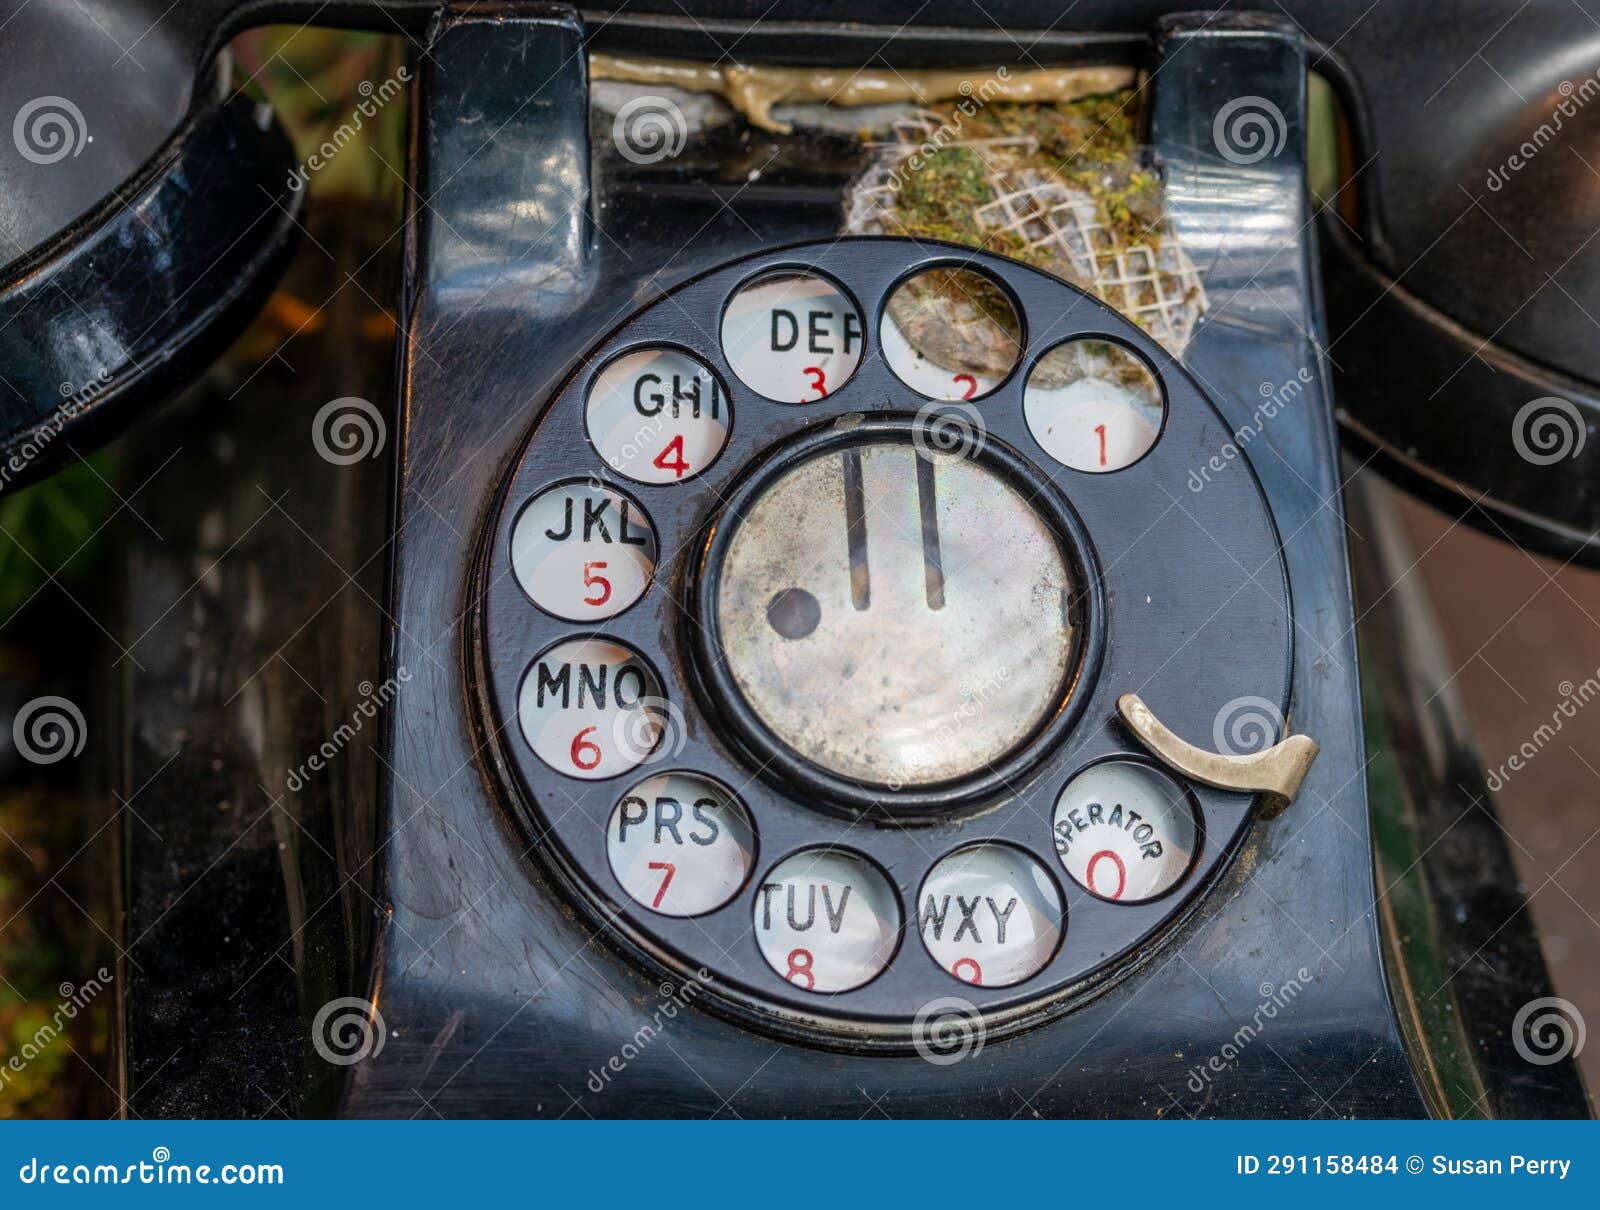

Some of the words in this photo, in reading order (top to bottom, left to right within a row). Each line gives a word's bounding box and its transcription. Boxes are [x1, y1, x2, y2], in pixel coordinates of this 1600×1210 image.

[771, 309, 861, 354] DEF
[634, 373, 719, 419] GHI
[803, 367, 828, 402] 3
[953, 373, 977, 400] 2
[653, 435, 690, 478] 4
[1094, 424, 1107, 466] 1
[544, 497, 647, 545] JKL
[583, 561, 612, 606] 5
[537, 662, 647, 711] MNO
[570, 725, 602, 771] 6
[619, 796, 719, 846] PRS
[648, 862, 676, 908] 7
[760, 883, 852, 933] TUV
[785, 948, 815, 991] 8
[951, 957, 982, 987] 9
